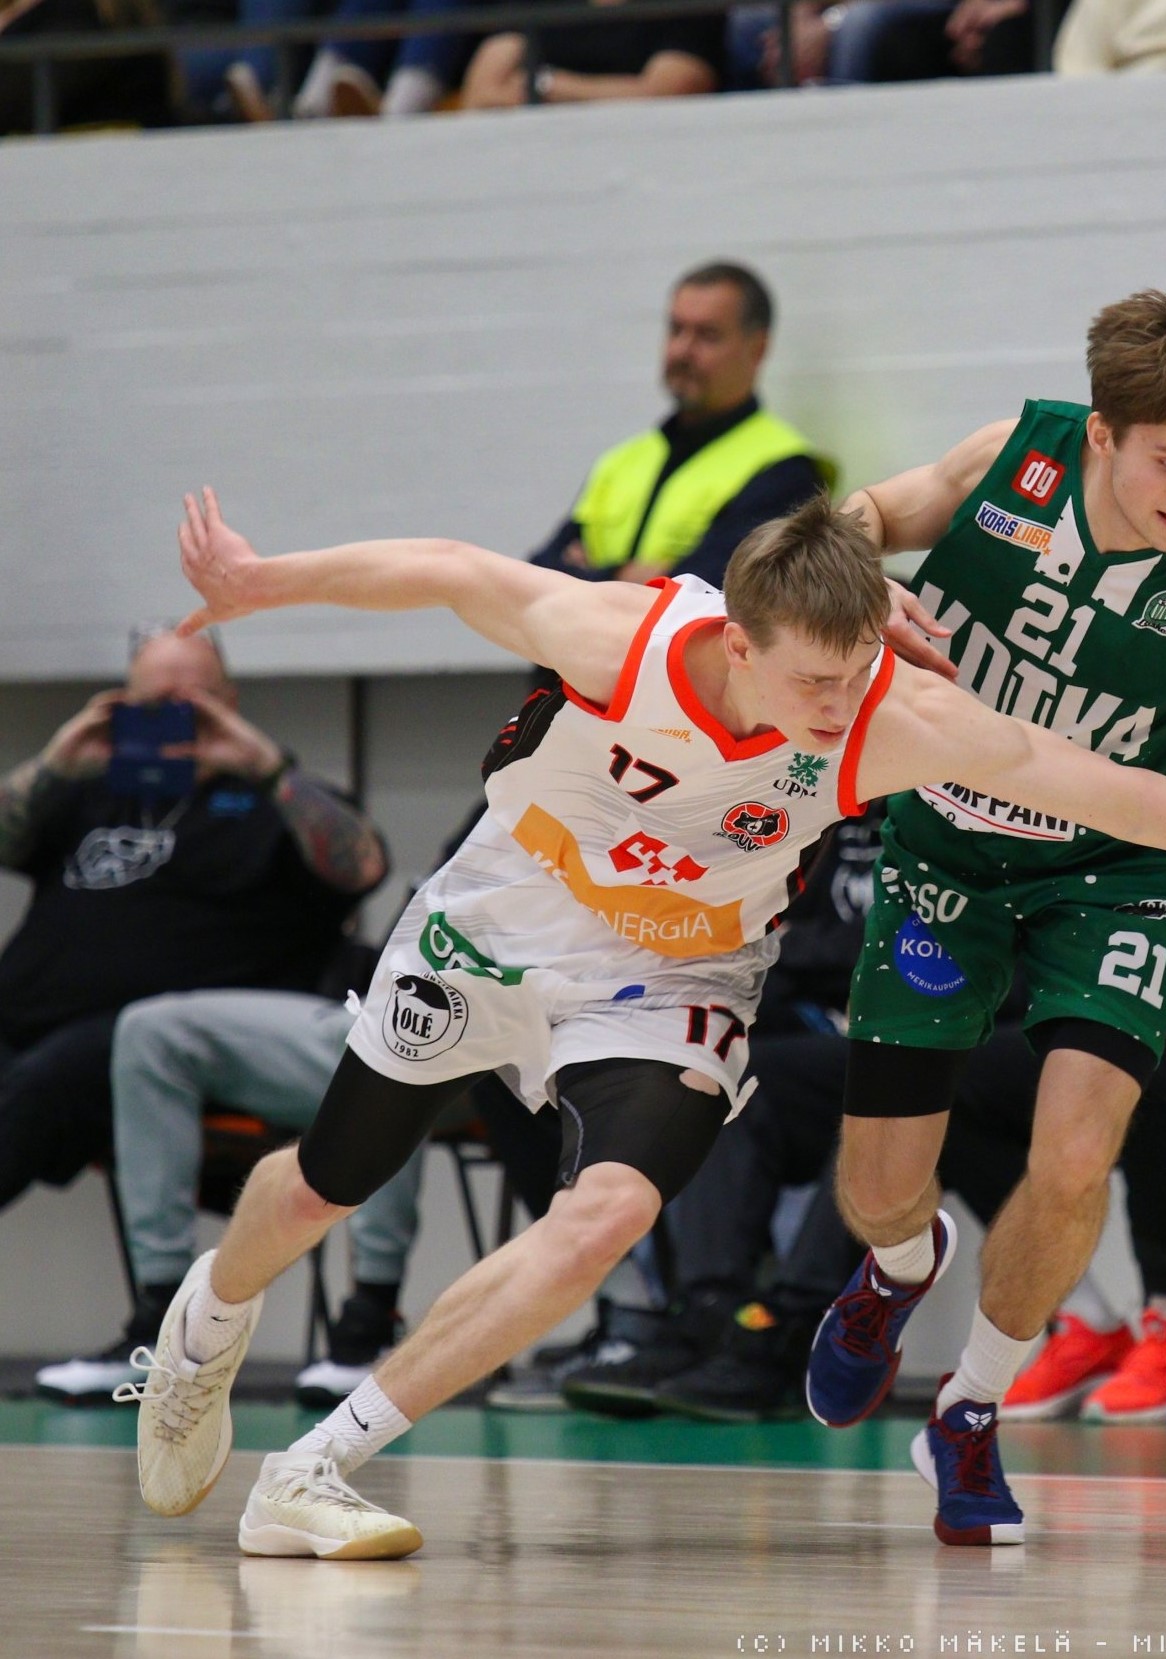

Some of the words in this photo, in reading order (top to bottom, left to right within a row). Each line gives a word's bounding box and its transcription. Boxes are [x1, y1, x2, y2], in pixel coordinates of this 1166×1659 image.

[1004, 582, 1096, 677] 21
[909, 581, 1157, 762] KOTKA
[608, 743, 680, 804] 17
[581, 901, 713, 943] NERGIA
[900, 938, 944, 960] KOT
[907, 971, 966, 992] MERIKAUPUNK
[400, 1007, 433, 1040] OLÉ
[682, 1004, 746, 1063] 17
[394, 1041, 420, 1058] 1982
